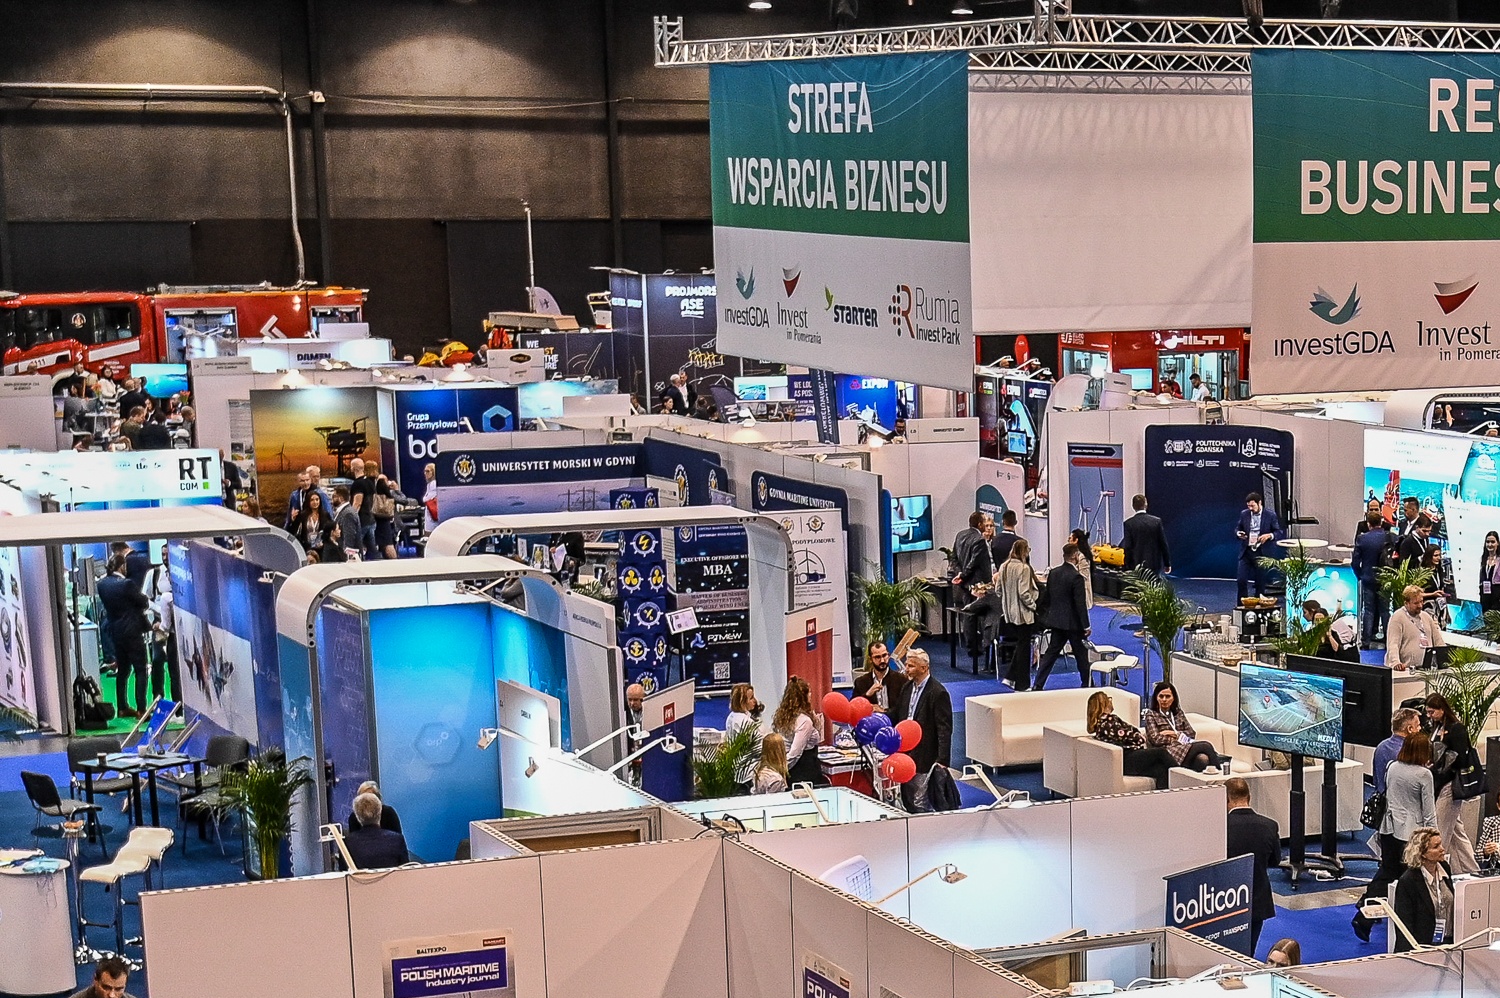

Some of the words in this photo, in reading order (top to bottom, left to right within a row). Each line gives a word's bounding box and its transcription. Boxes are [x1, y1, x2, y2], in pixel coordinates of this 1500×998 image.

[787, 81, 874, 134] STREFA
[728, 157, 838, 210] WSPARCIA
[845, 160, 948, 215] BIZNESU
[915, 287, 961, 325] Rumia
[724, 305, 770, 328] investGDA
[777, 301, 808, 329] Invest
[794, 329, 822, 345] Pomerania
[916, 323, 941, 343] Invest
[942, 327, 961, 346] Park
[1416, 320, 1492, 347] Invest
[1274, 330, 1396, 358] investGDA
[1439, 346, 1453, 361] in
[406, 412, 430, 422] Grupa
[406, 419, 458, 430] Przemysłowa
[482, 460, 550, 472] UNIWERSYTET
[552, 458, 592, 470] MORSKI
[592, 457, 603, 467] W
[605, 456, 636, 467] GDYNI
[179, 481, 199, 491] COM
[769, 487, 786, 500] GDYNIA
[786, 491, 809, 506] MARITIME
[702, 563, 733, 577] MBA
[1317, 734, 1336, 744] MEDIA
[1173, 883, 1249, 924] balticon
[1222, 922, 1249, 937] TRANSPORT
[416, 946, 447, 955] BALTEXPO
[401, 968, 442, 983] POLISH
[443, 962, 500, 978] MARITIME
[467, 972, 500, 984] journal
